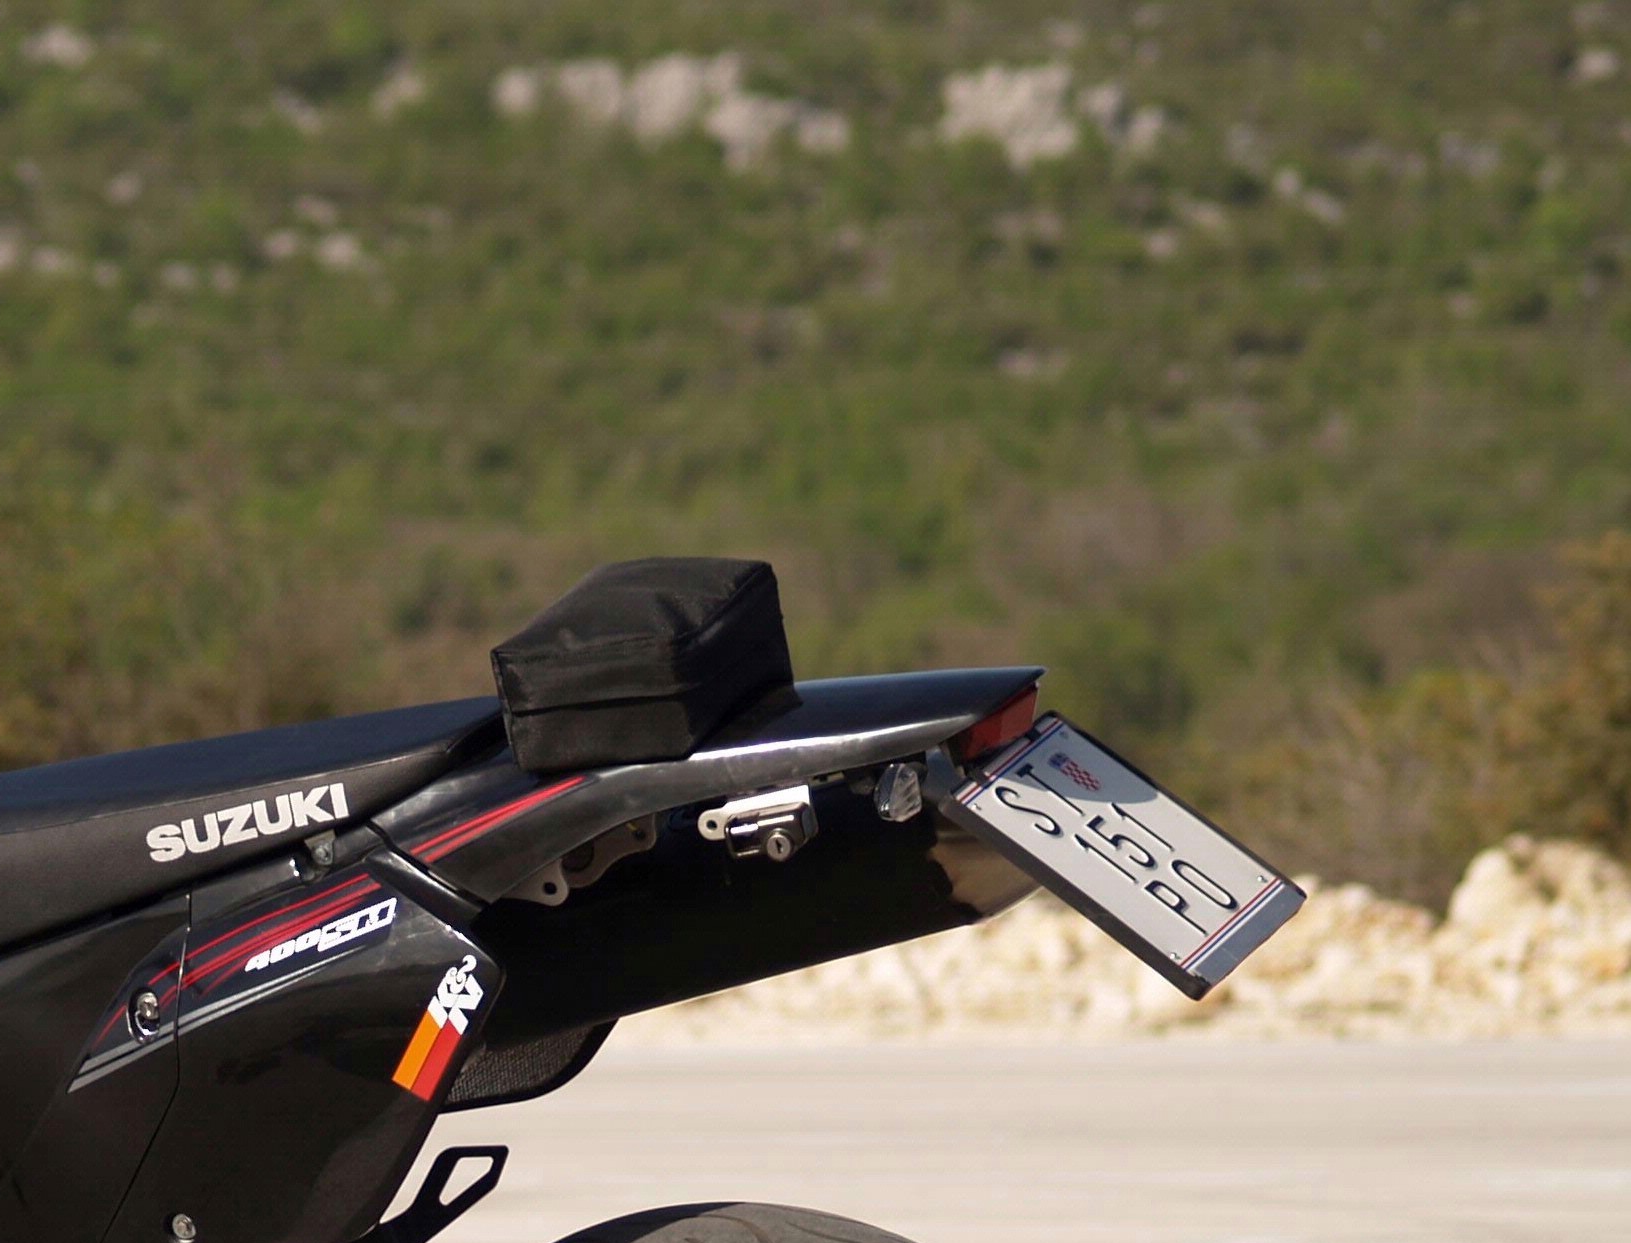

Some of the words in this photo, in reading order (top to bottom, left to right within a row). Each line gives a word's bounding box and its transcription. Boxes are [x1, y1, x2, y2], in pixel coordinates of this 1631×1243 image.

[146, 782, 349, 863] SUZUKI
[995, 763, 1085, 837] ST
[1074, 802, 1175, 884] 151
